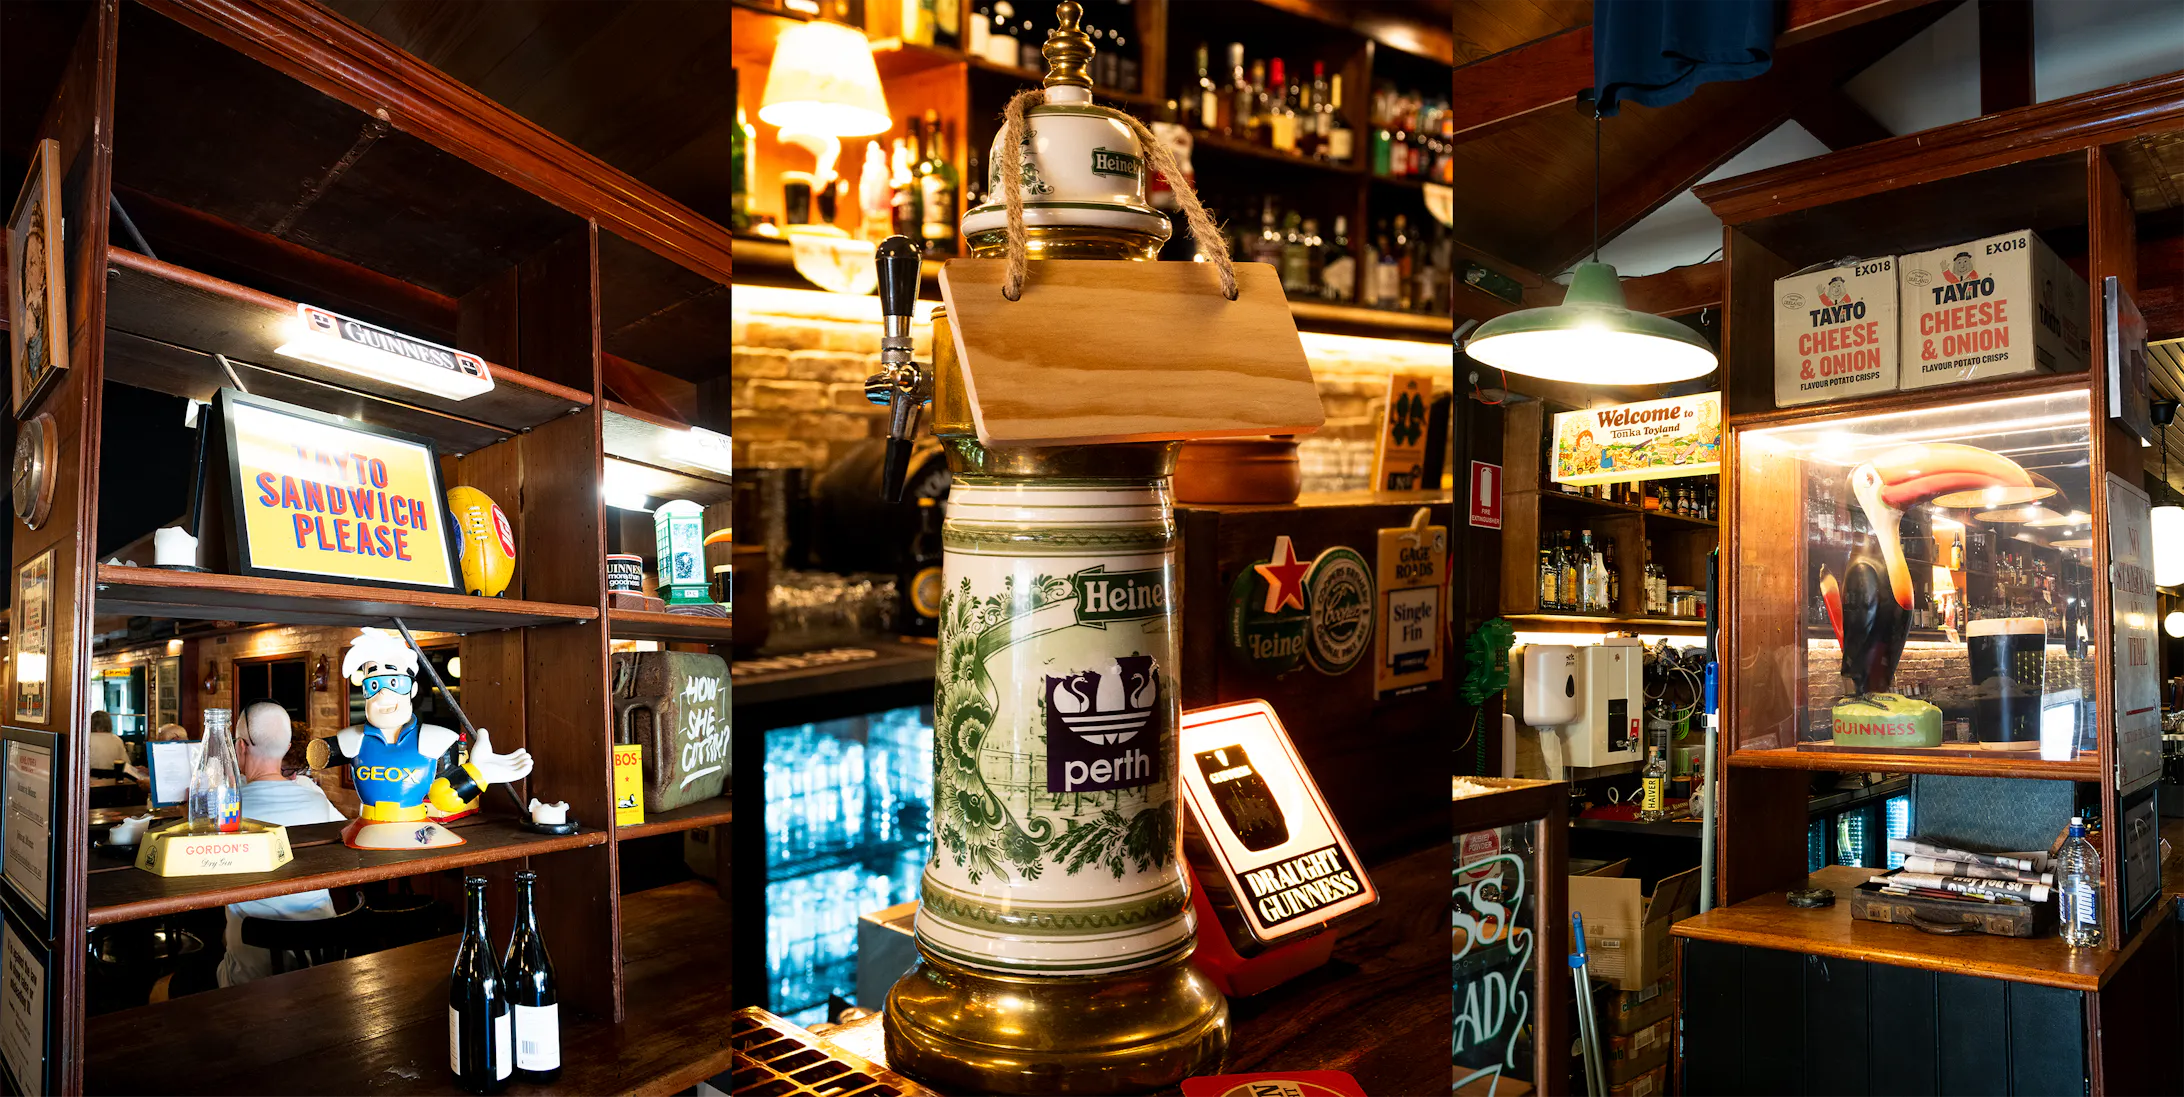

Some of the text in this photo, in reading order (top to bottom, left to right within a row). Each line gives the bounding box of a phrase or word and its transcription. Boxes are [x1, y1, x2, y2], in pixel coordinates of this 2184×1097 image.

[1932, 276, 1994, 306] TAYTO
[1810, 301, 1866, 328] TAYTO
[1920, 299, 2008, 336] CHEESE
[344, 322, 454, 370] GUINNESS
[1798, 321, 1878, 356] CHEESE
[1921, 326, 2010, 361] & ONION
[1800, 348, 1880, 380] & ONION
[1922, 352, 2008, 373] FLAVOUR POTATO CRISPS
[1800, 372, 1880, 391] FLAVOUR POTATO CRISPS
[1597, 406, 1681, 428] Welcome
[1610, 423, 1680, 438] Tonka Toyland
[256, 472, 428, 530] SANDWICH
[292, 512, 412, 561] PLEASE
[2128, 526, 2140, 556] NO
[1396, 561, 1434, 580] ROADS
[2115, 562, 2155, 598] STANDING
[1394, 602, 1432, 624] Single
[1403, 623, 1422, 642] Fin
[2128, 636, 2148, 666] TIME
[686, 675, 720, 705] HOW
[687, 706, 716, 740] SHE
[1834, 718, 1916, 736] GUINNESS
[356, 766, 421, 784] GEOX
[1064, 748, 1150, 792] perth
[1648, 780, 1656, 808] HAIVER
[186, 844, 249, 855] GORDON'S
[1468, 841, 1492, 852] POWDER
[201, 858, 232, 868] Dry Gin
[1244, 848, 1343, 898] DRAUGHT
[1258, 870, 1358, 922] GUINNESS
[1979, 878, 2005, 890] you
[2006, 882, 2024, 892] so
[1453, 971, 1508, 1056] AD
